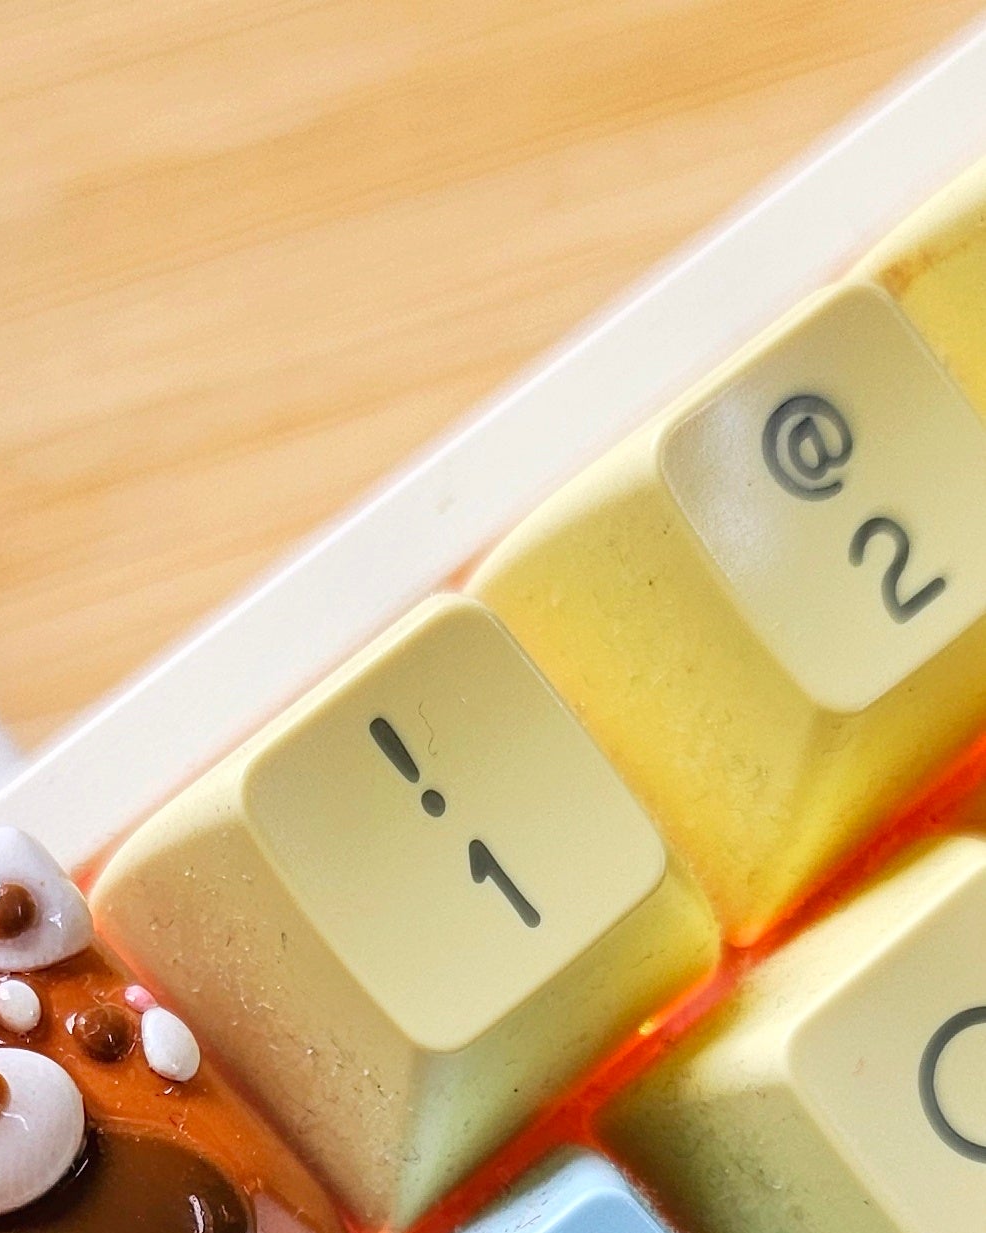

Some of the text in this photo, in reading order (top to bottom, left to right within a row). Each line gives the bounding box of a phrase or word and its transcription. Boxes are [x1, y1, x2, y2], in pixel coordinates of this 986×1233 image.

[763, 393, 853, 499] @
[849, 516, 946, 624] 2
[369, 716, 446, 818] !
[469, 839, 541, 928] 1
